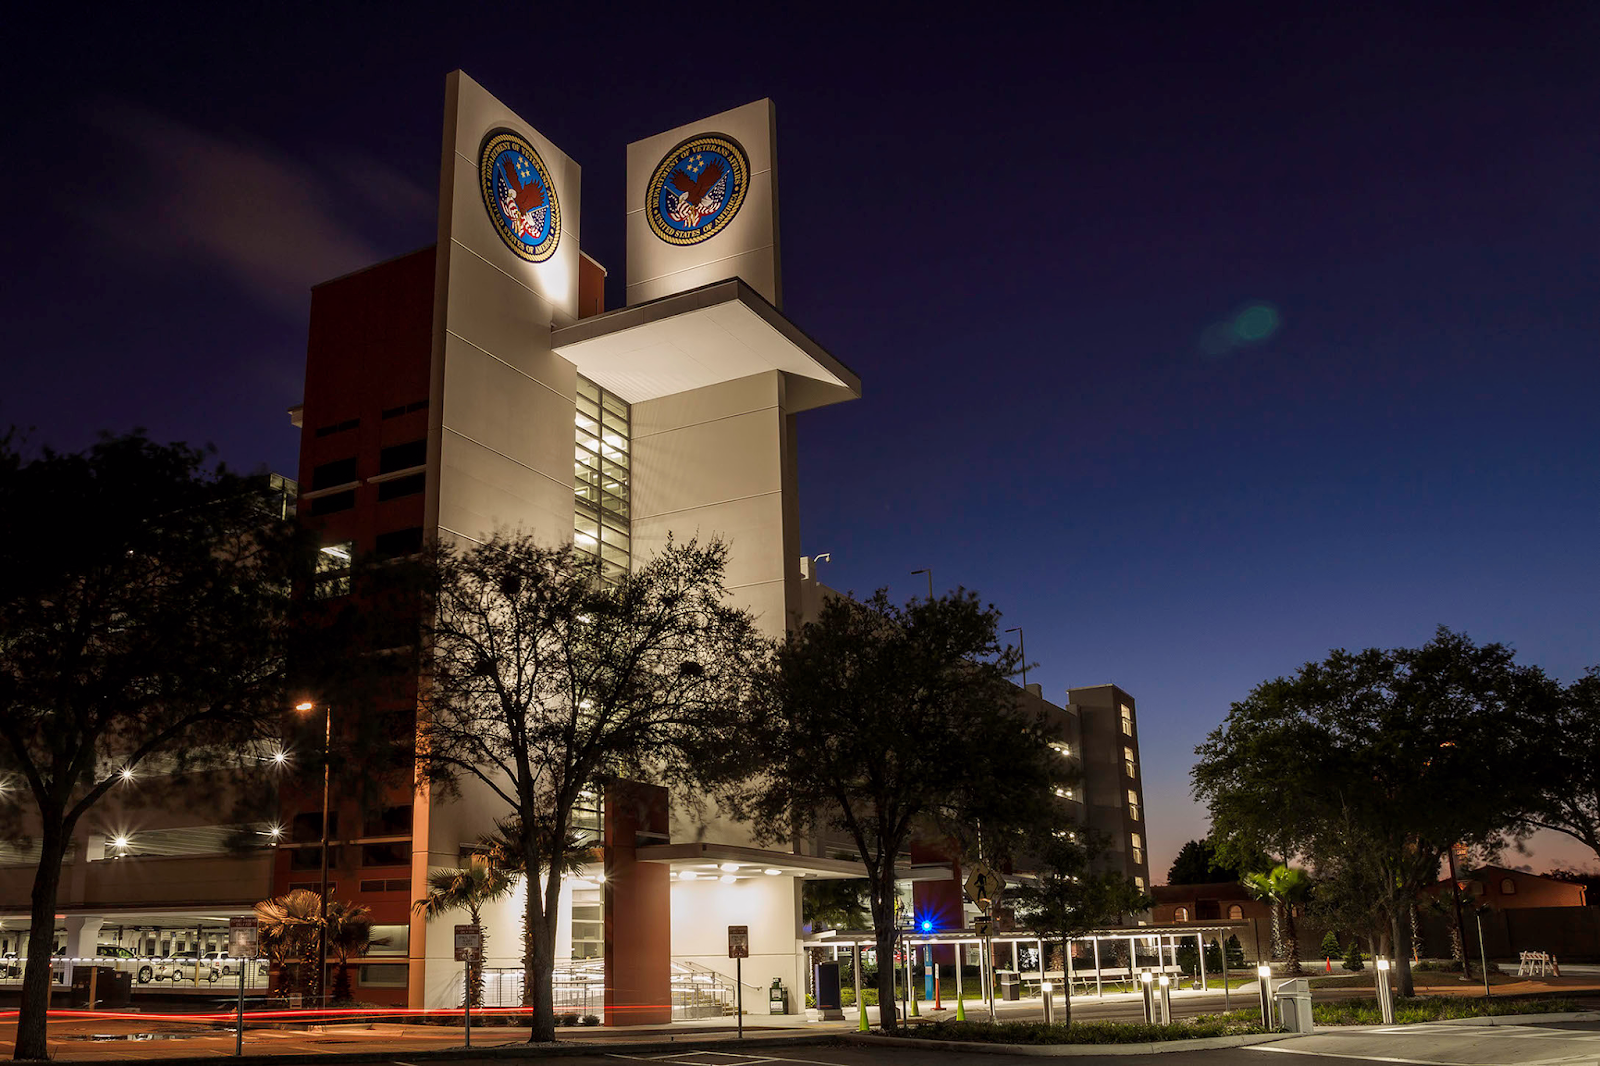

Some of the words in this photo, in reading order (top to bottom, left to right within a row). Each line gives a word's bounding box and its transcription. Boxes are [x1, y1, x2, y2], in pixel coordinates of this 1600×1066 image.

[486, 141, 511, 180] DEPARTMENT
[511, 142, 520, 153] OF
[521, 146, 550, 188] VETERANS
[652, 157, 679, 208] DEPARTMENT
[680, 150, 691, 159] OF
[691, 144, 730, 156] VETERANS
[727, 155, 742, 186] AFFAIRS
[487, 189, 505, 227] UNITED
[504, 225, 525, 250] STATES
[525, 244, 535, 254] OF
[534, 234, 554, 255] AMERICA
[654, 214, 674, 235] UNITED
[674, 228, 700, 239] STATES
[702, 223, 713, 233] OF
[714, 192, 739, 227] AMERICA
